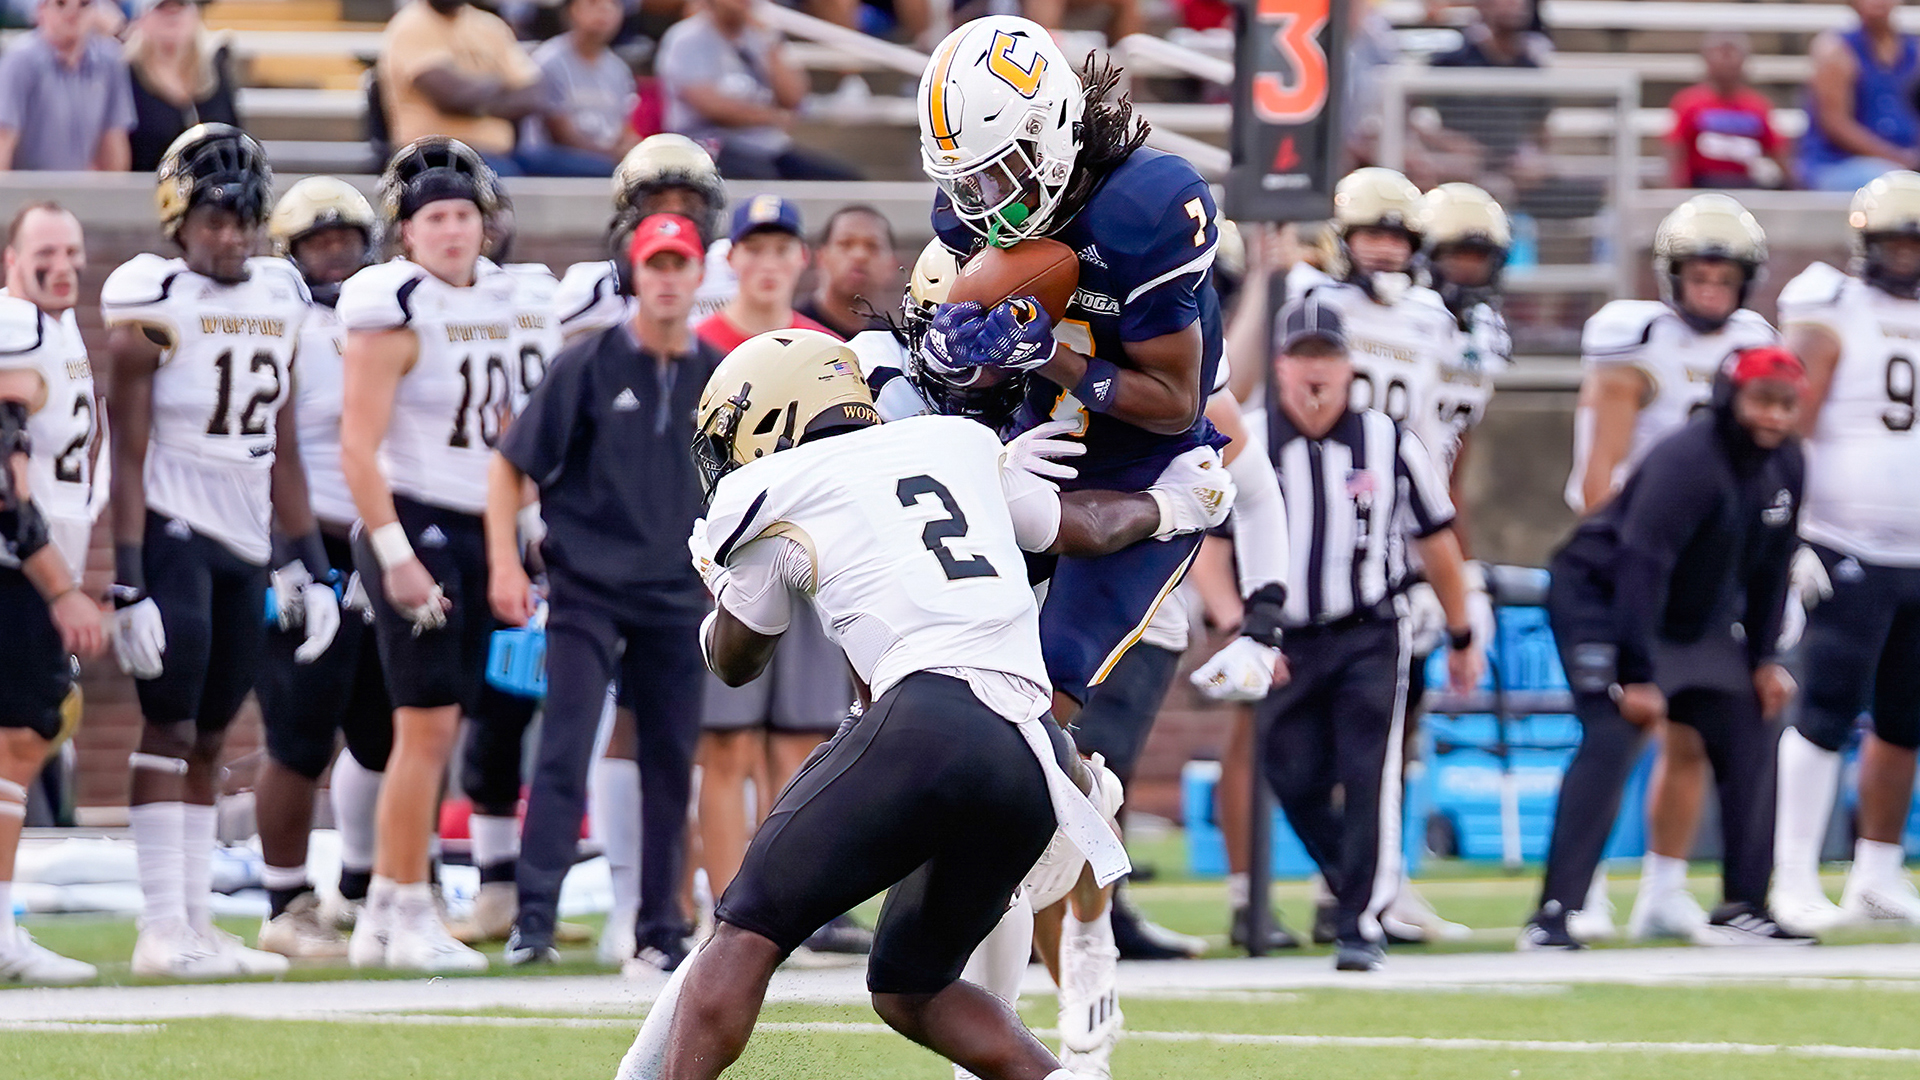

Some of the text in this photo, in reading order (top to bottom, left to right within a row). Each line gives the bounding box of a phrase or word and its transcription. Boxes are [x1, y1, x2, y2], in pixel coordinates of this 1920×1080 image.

[986, 28, 1049, 100] C
[1252, 0, 1330, 126] 3
[1183, 196, 1208, 248] 7
[206, 347, 282, 436] 12
[447, 353, 511, 450] 10
[1881, 355, 1916, 431] 9
[55, 393, 92, 483] 2
[895, 473, 1000, 581] 2
